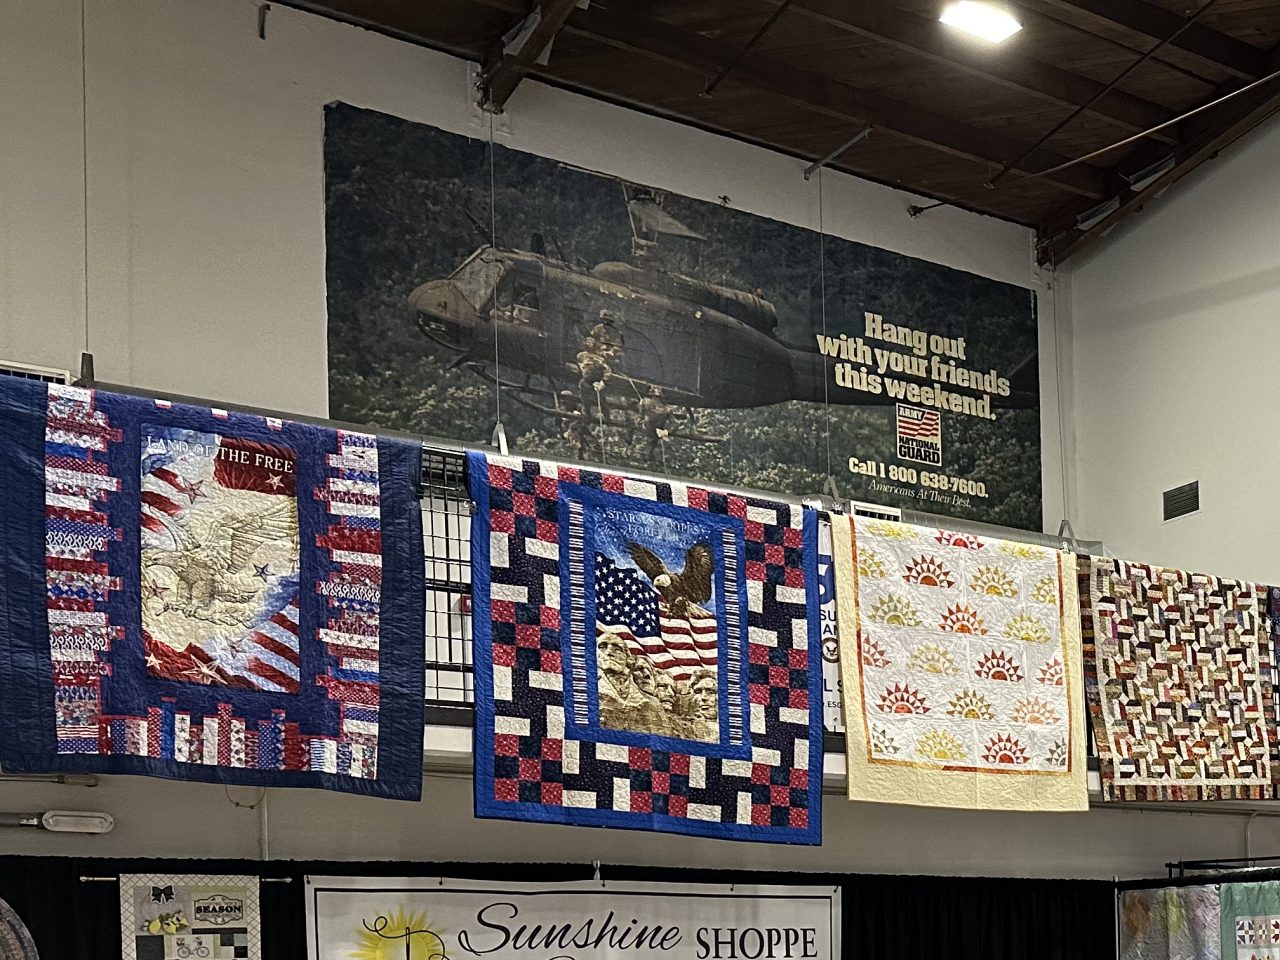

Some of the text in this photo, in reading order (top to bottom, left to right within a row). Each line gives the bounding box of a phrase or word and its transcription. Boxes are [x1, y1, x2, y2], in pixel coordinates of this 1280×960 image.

[864, 311, 966, 361] Hang out
[816, 333, 1011, 397] with your friends
[834, 363, 997, 421] this weekend.
[899, 406, 924, 420] ARMY
[147, 436, 294, 473] LAND OF THE FREE
[898, 435, 940, 452] NATIONAL
[898, 445, 941, 464] GUARD
[849, 457, 989, 498] Call 1 800 638-7600.
[868, 479, 971, 508] Americans At Their Best.
[195, 905, 242, 915] SEASON
[458, 902, 819, 960] Sunshine SHOPPE
